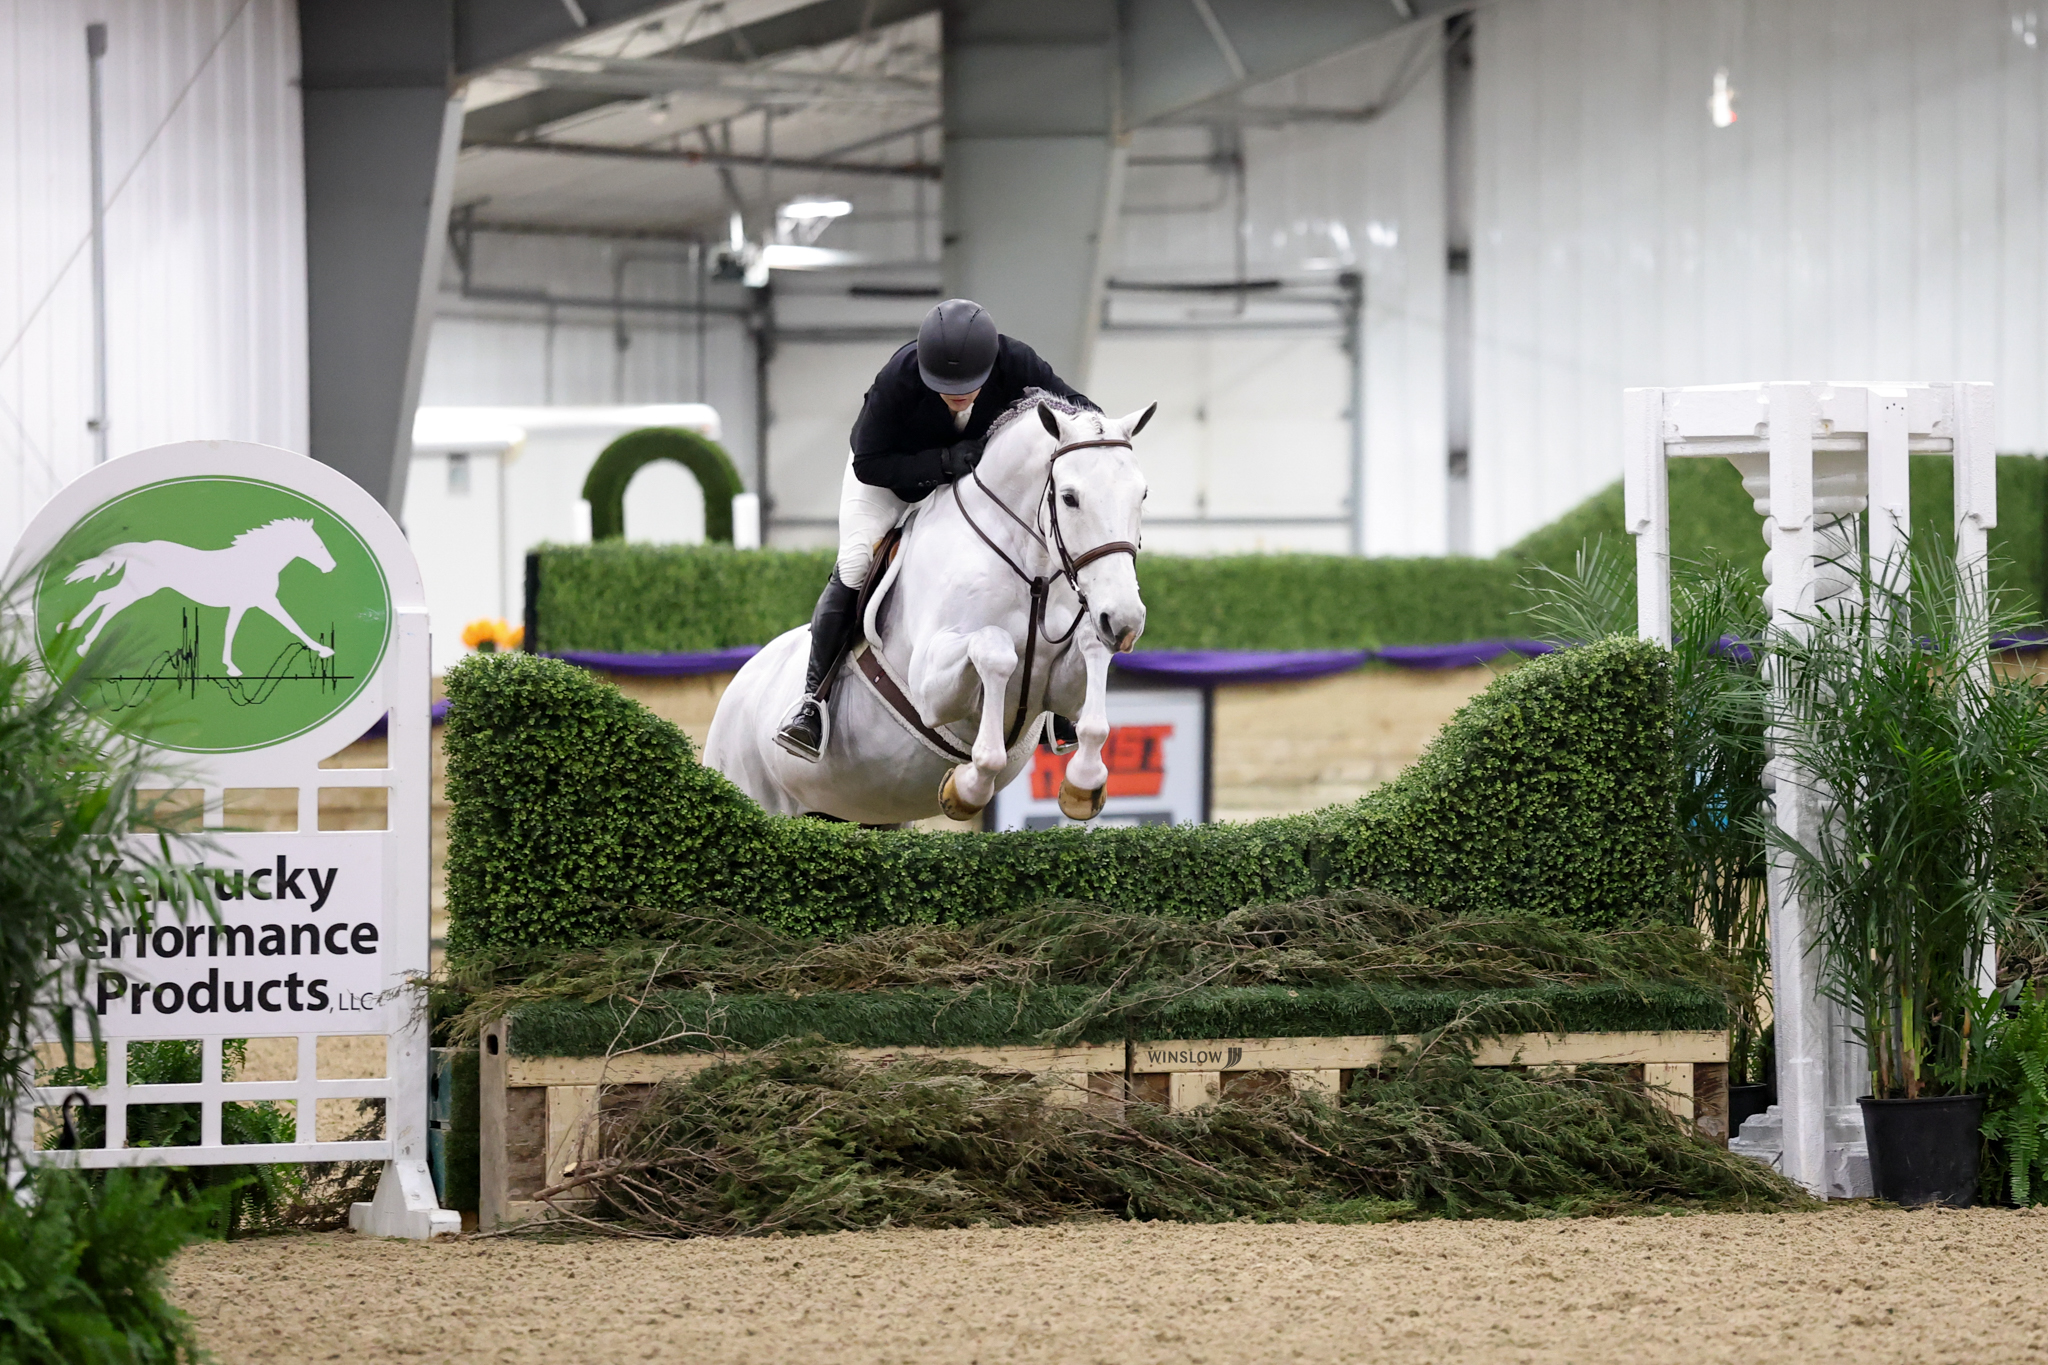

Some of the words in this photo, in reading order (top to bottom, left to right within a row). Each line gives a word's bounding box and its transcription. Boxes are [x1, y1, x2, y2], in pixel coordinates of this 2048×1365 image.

[46, 911, 379, 960] Performance
[97, 967, 334, 1015] Products,
[338, 992, 374, 1011] LLC
[1147, 1050, 1223, 1064] WINSLOW
